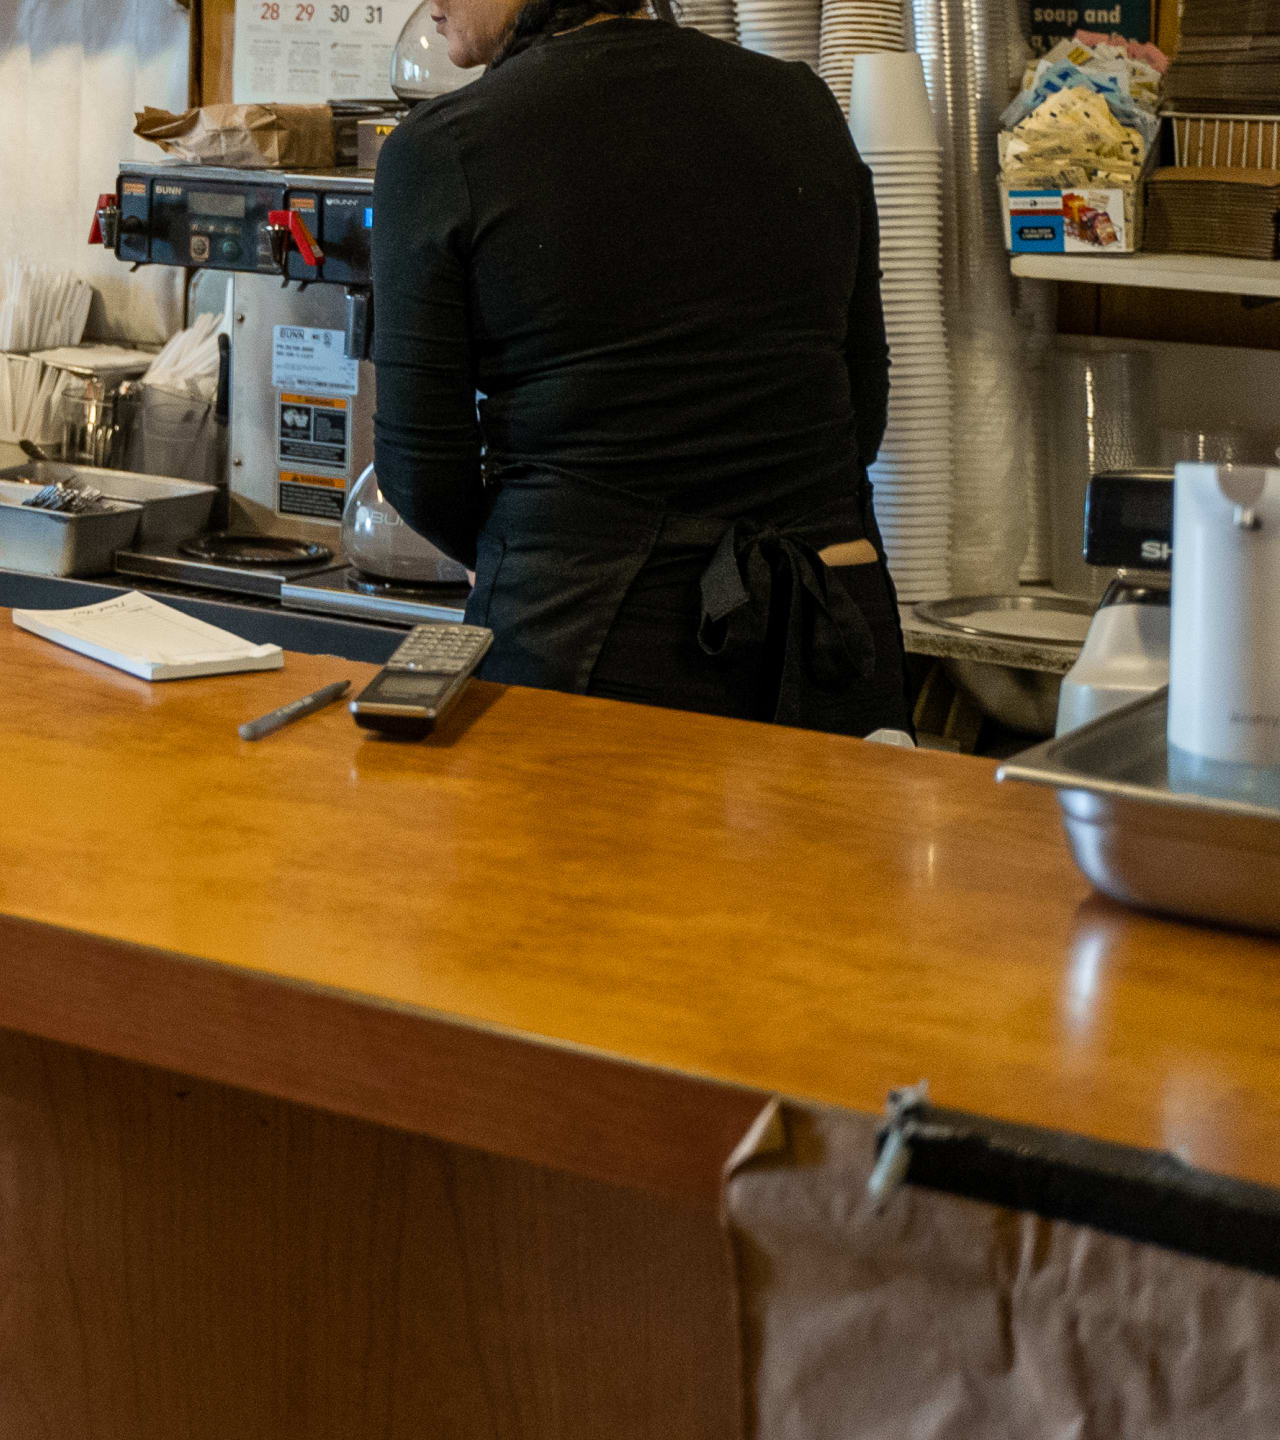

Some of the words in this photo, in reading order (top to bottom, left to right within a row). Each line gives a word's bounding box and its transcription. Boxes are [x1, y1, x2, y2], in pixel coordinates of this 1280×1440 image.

[261, 3, 280, 20] 28
[295, 4, 314, 21] 29
[330, 5, 350, 22] 30
[365, 5, 383, 24] 31
[1034, 8, 1078, 26] soap
[1084, 5, 1121, 24] and
[155, 185, 182, 196] BUNN
